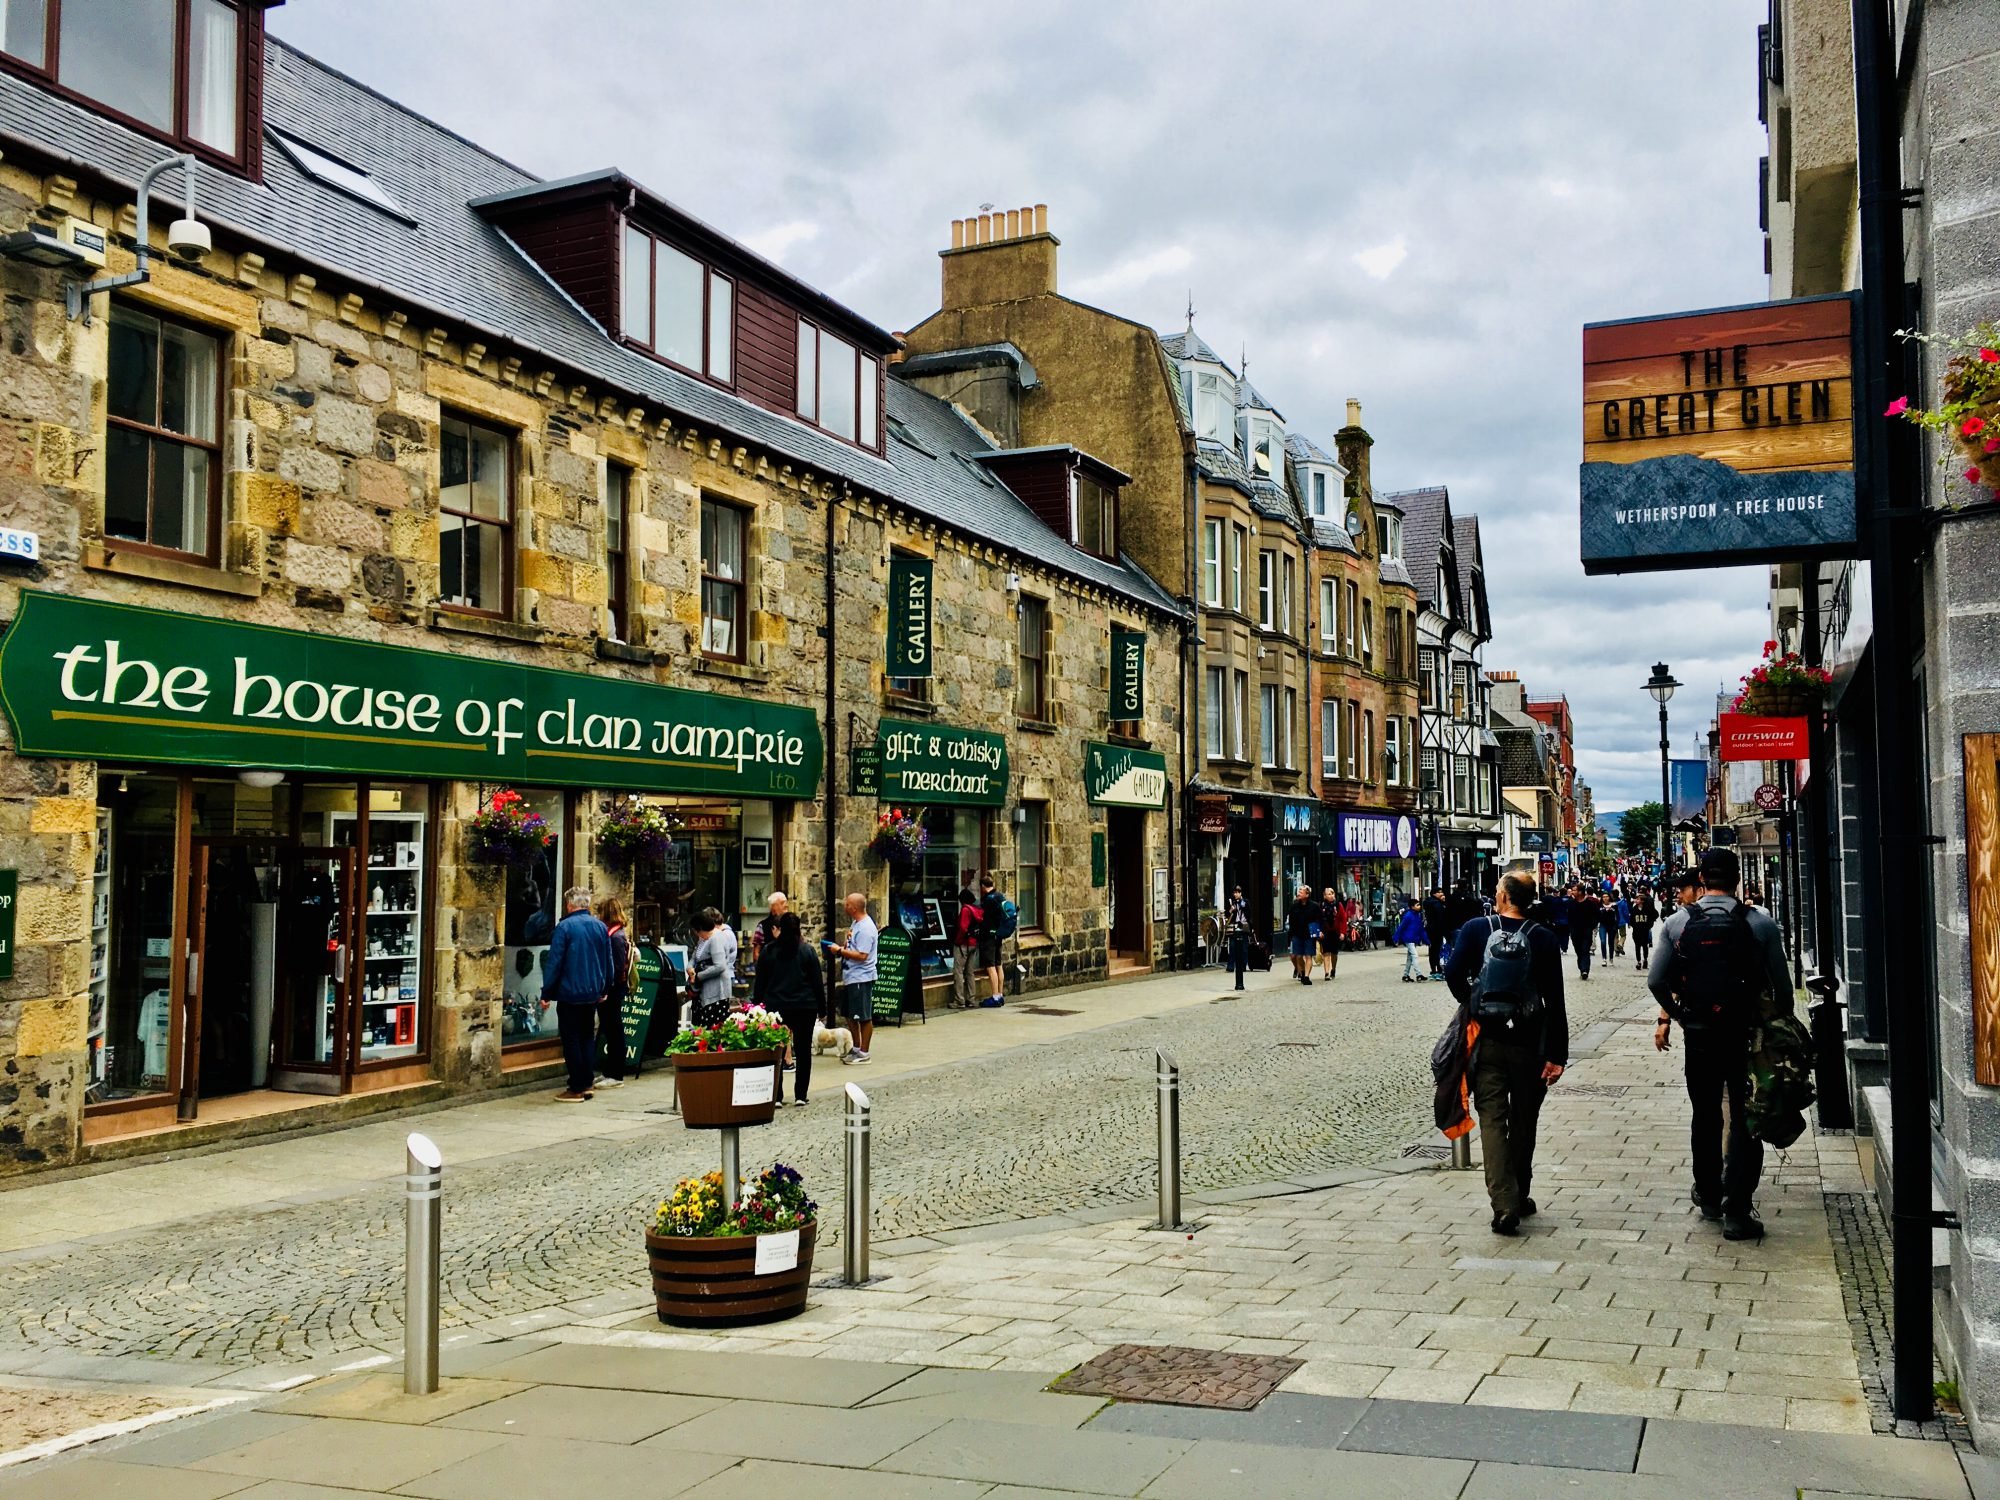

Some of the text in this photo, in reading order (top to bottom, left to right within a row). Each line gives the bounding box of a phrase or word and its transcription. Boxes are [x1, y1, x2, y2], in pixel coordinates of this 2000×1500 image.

[1680, 344, 1748, 387] THE
[1603, 380, 1830, 438] GREAT GLEN
[1615, 503, 1717, 525] WETHERSPOON
[1736, 499, 1770, 516] FREE
[1776, 495, 1825, 512] HOUSE
[908, 572, 926, 664] GALLERY
[1125, 642, 1139, 710] GALLERY
[52, 639, 211, 713] the
[233, 656, 443, 733] house
[455, 697, 525, 756] of
[537, 698, 642, 751] clan
[886, 731, 1002, 770] gift & whisky
[1731, 731, 1795, 741] COTSWOLD
[856, 785, 878, 795] Whisky
[901, 768, 989, 794] merchant
[1133, 771, 1162, 801] GALLERY
[1759, 786, 1777, 794] COSTA
[690, 817, 723, 827] SALE
[1344, 817, 1357, 852] OFF
[631, 1005, 652, 1017] Tweed
